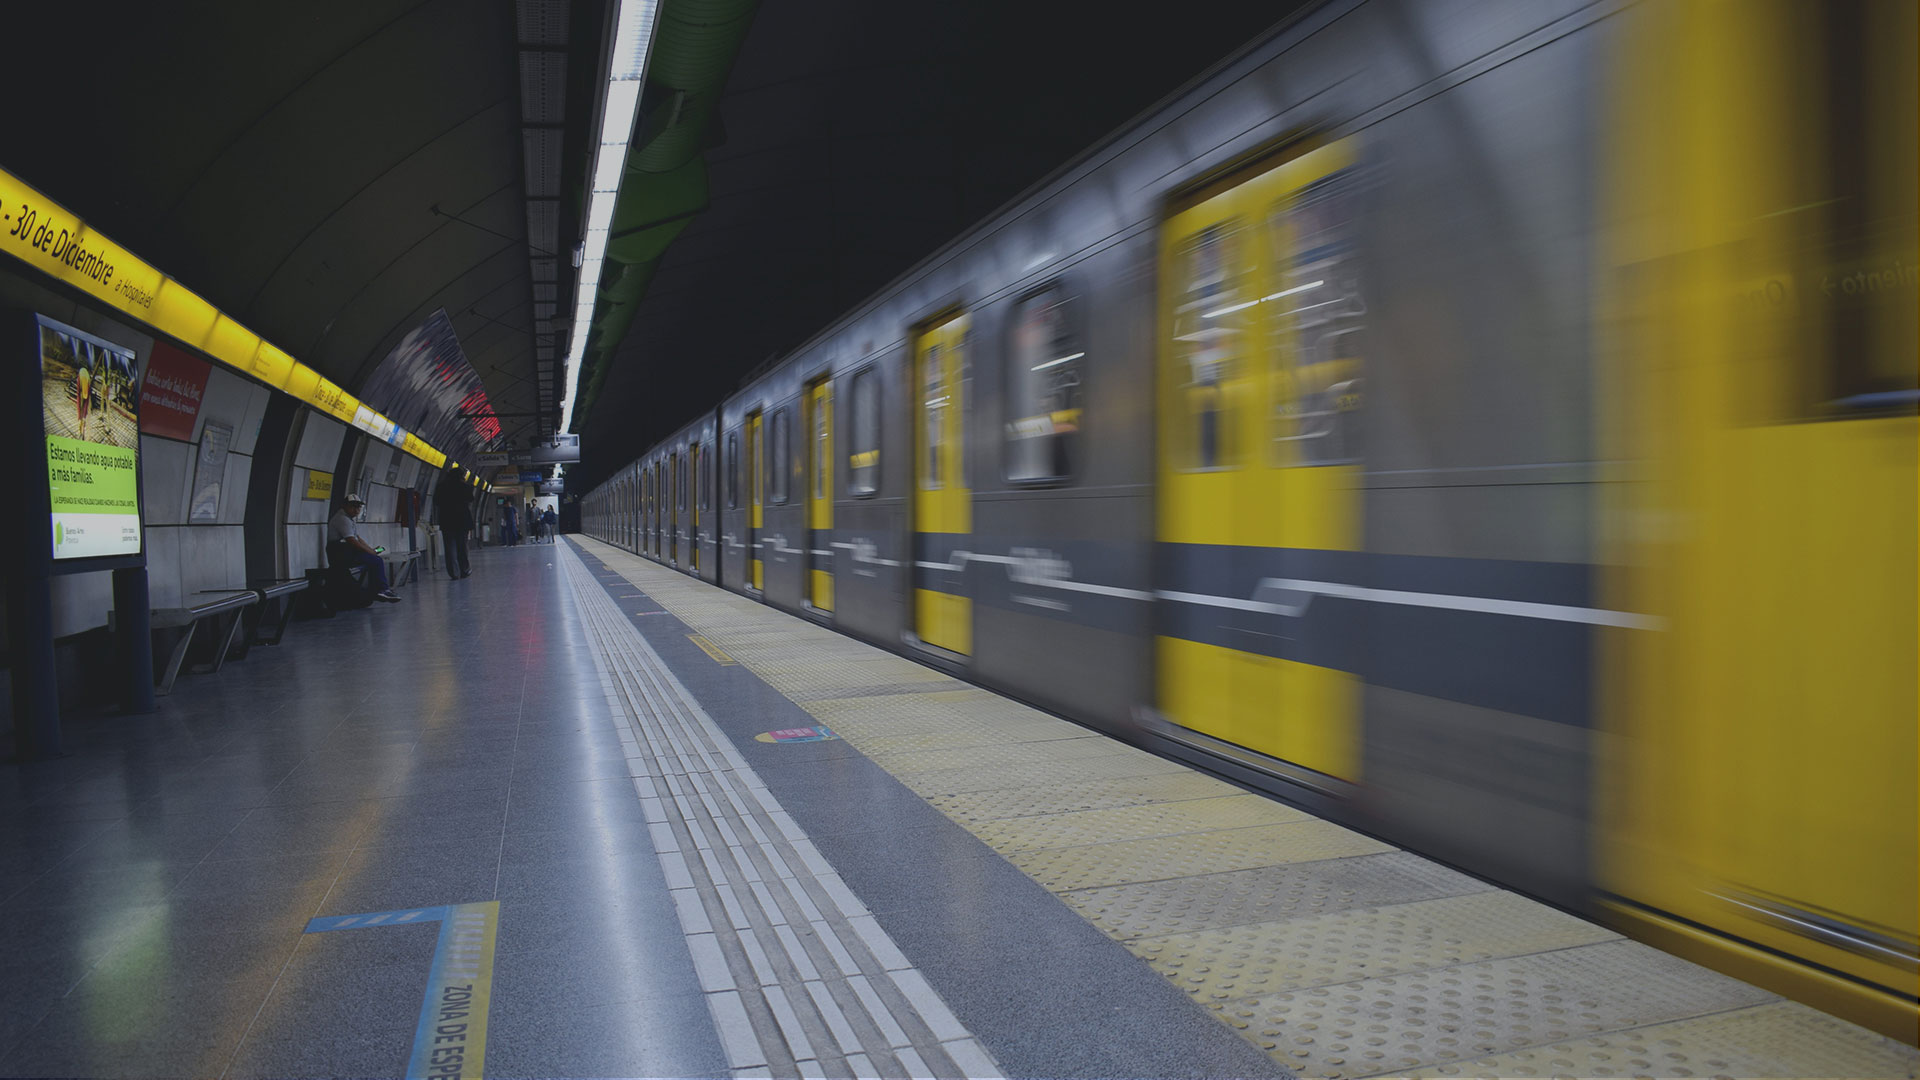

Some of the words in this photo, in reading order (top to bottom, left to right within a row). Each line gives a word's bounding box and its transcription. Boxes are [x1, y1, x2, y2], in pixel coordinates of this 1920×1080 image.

[10, 204, 37, 241] 30
[32, 217, 53, 253] de
[51, 228, 115, 287] Diciembre
[115, 279, 122, 292] a
[121, 278, 154, 309] Hospitales
[50, 442, 76, 463] Estamos
[76, 447, 100, 466] llevando
[100, 455, 113, 471] agua
[114, 455, 133, 471] potable
[51, 468, 56, 480] a
[57, 465, 70, 482] más
[70, 466, 94, 484] familias.
[439, 984, 473, 1022] ZONA
[434, 1022, 468, 1045] DE
